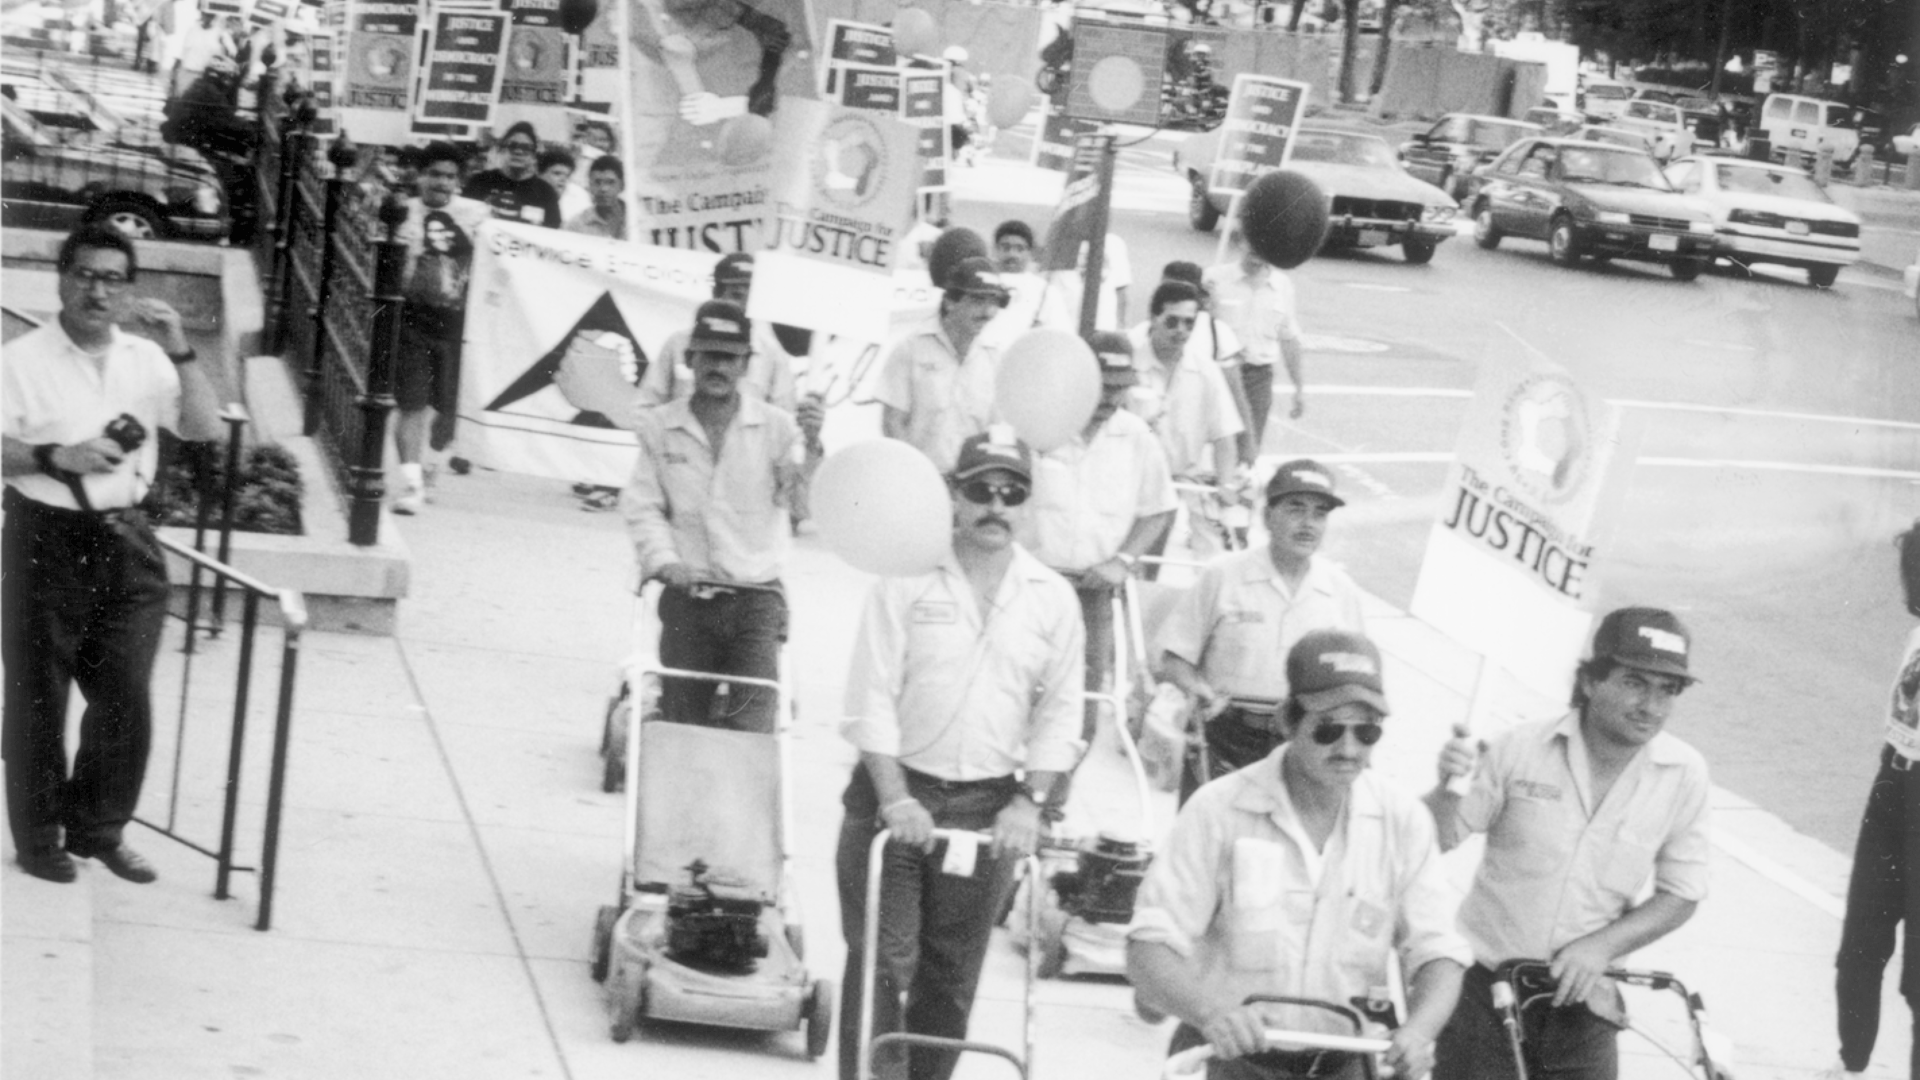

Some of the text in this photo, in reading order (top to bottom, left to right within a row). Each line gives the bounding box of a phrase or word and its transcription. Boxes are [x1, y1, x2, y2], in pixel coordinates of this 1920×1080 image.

[445, 17, 495, 31] JUSTICE
[843, 29, 892, 47] JUSTICE
[432, 50, 499, 66] DEMOCRACY
[1243, 83, 1291, 102] JUSTICE
[640, 184, 769, 215] The Campai
[650, 218, 763, 254] JUST
[808, 207, 872, 233] Campaign
[874, 222, 893, 238] for
[490, 232, 593, 270] Service
[763, 217, 892, 268] JUSTICE
[1460, 463, 1596, 558] The Campaign for
[1443, 486, 1589, 600] JUSTICE
